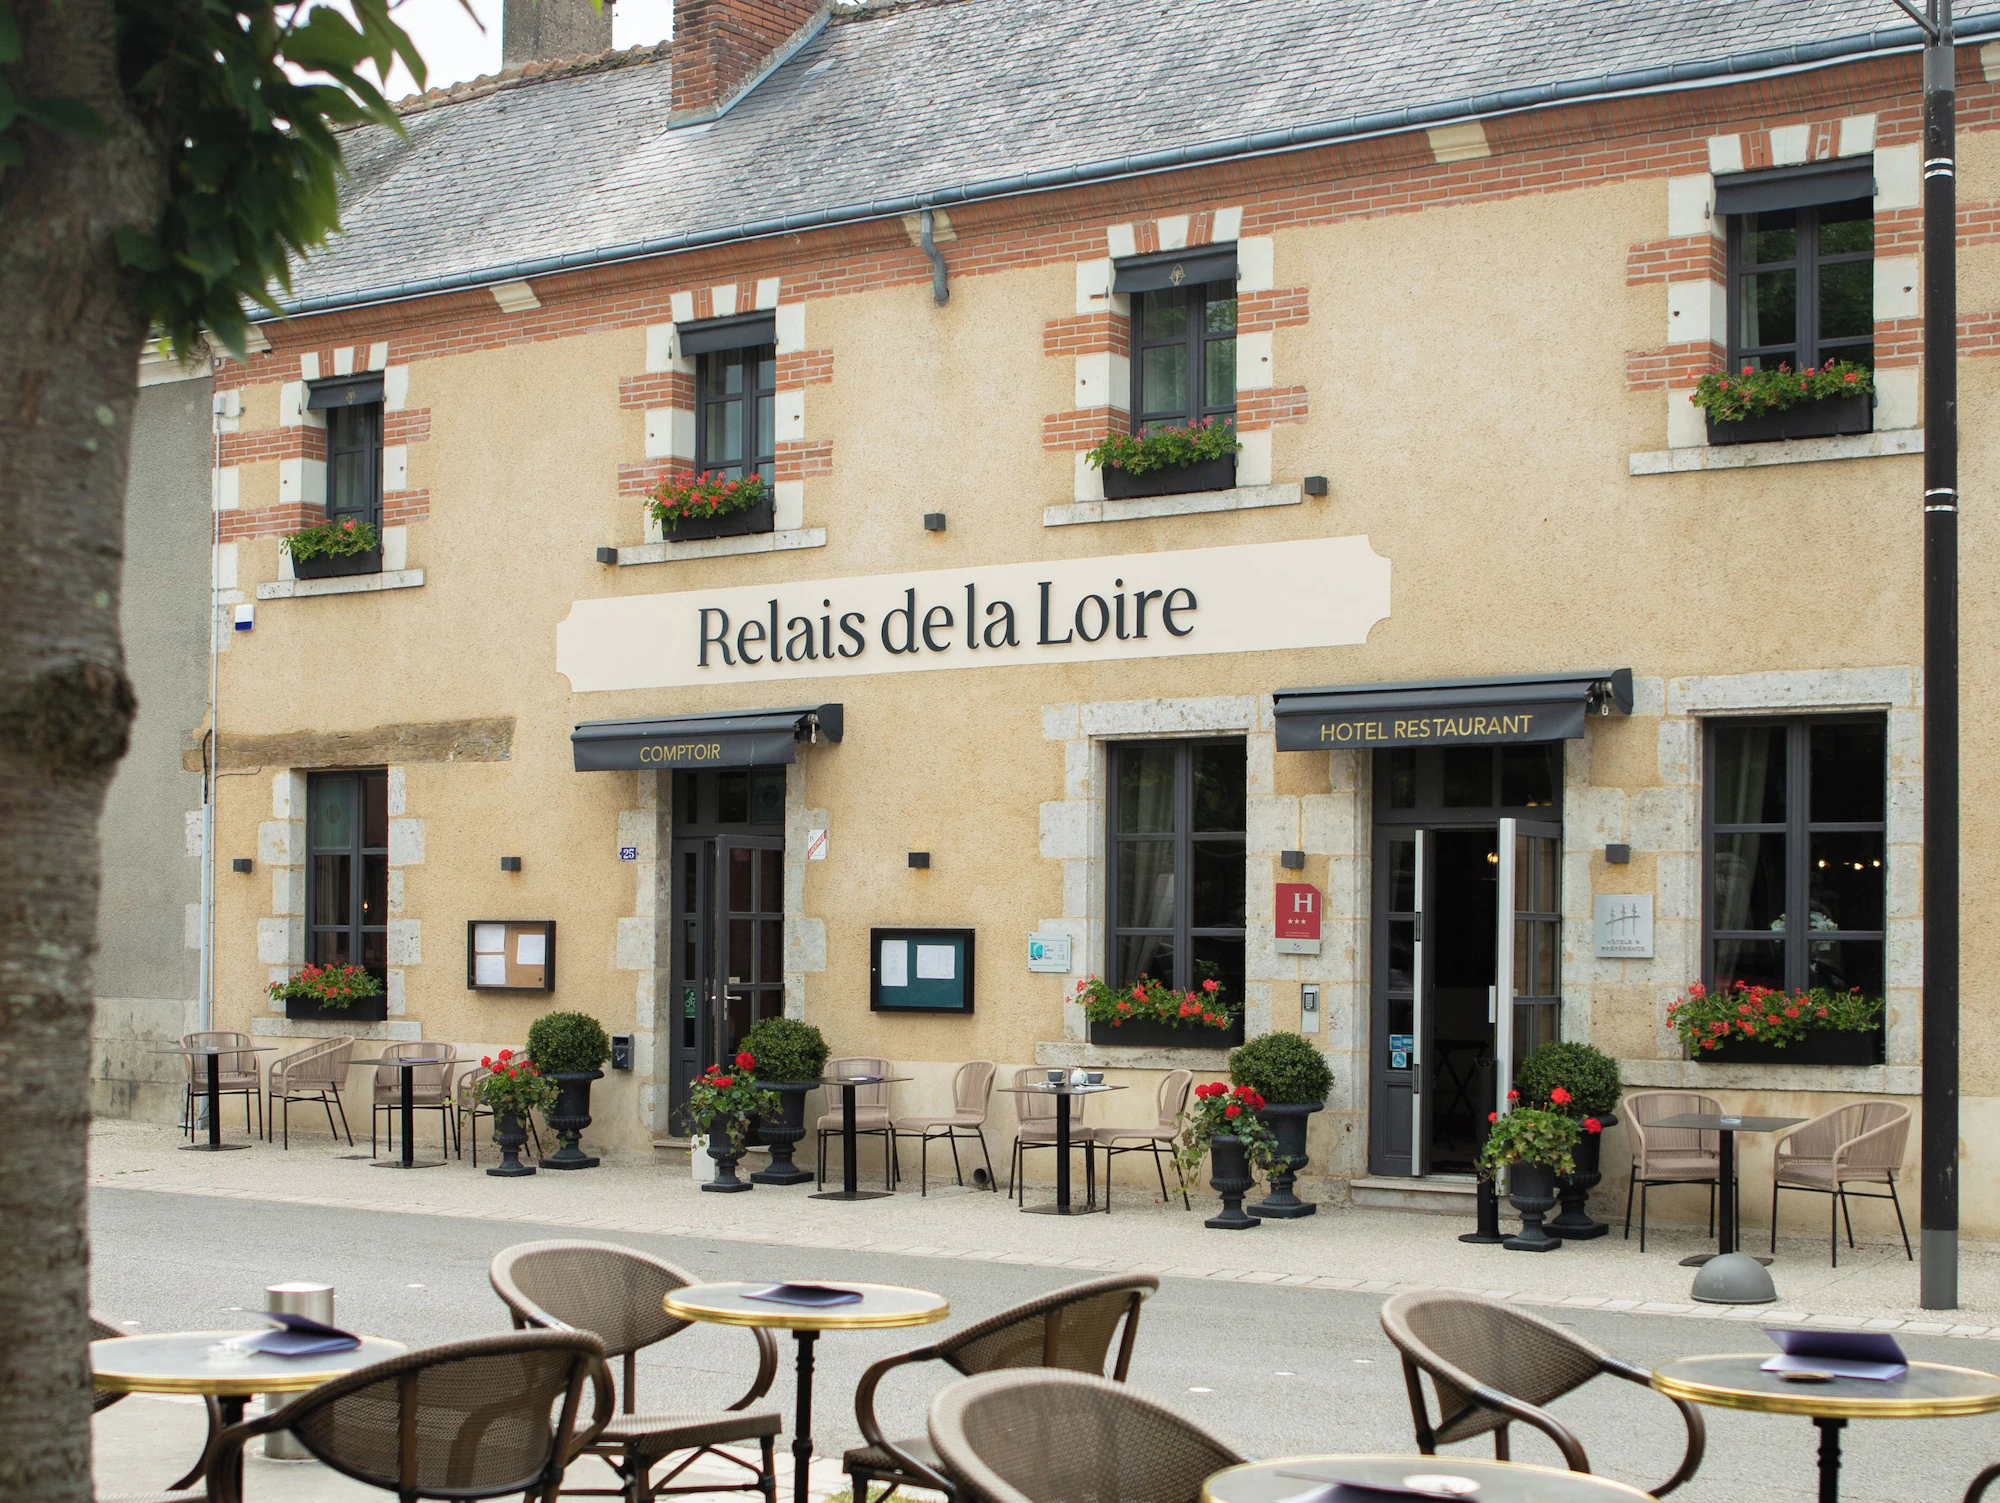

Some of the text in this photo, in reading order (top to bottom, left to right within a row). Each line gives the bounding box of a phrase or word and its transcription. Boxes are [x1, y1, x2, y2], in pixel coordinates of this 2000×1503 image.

[697, 578, 1198, 667] Relais de la Loire
[1321, 714, 1534, 742] HOTEL RESTAURANT
[640, 743, 721, 762] COMPTOIR
[622, 848, 635, 859] 25
[1292, 892, 1315, 914] H
